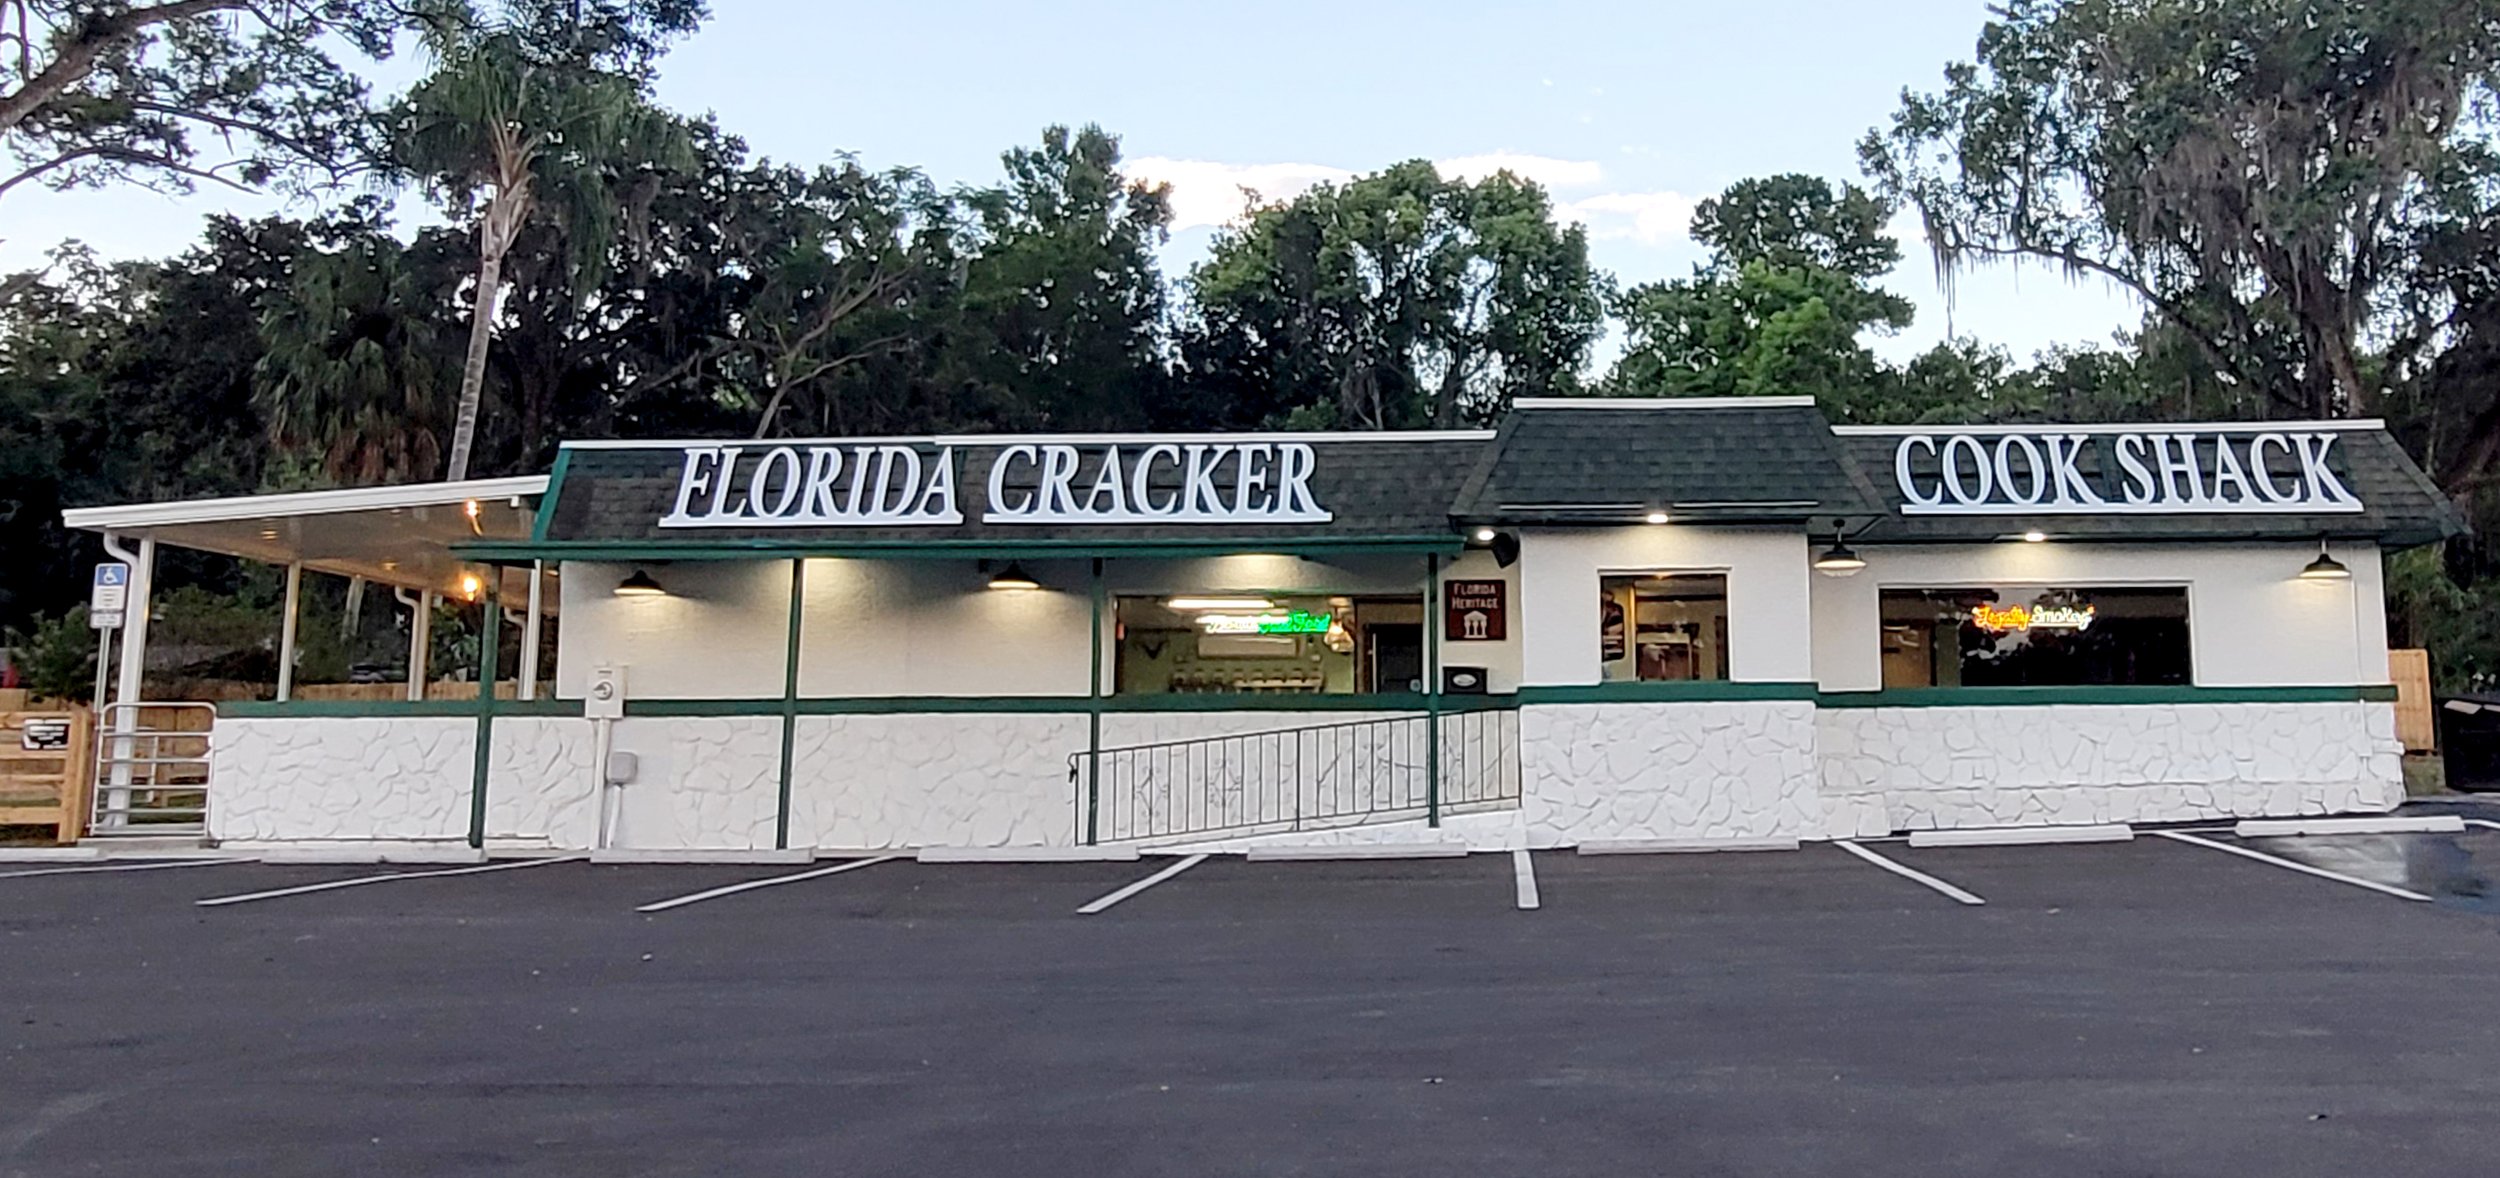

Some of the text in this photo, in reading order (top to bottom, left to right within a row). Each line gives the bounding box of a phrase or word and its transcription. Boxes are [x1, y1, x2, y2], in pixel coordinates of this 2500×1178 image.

[659, 443, 1333, 527] FLORIDA CRACKER
[1896, 433, 2365, 513] COOK SHACK
[1452, 596, 1498, 610] HERITAGE
[1454, 583, 1496, 596] FLORIDA
